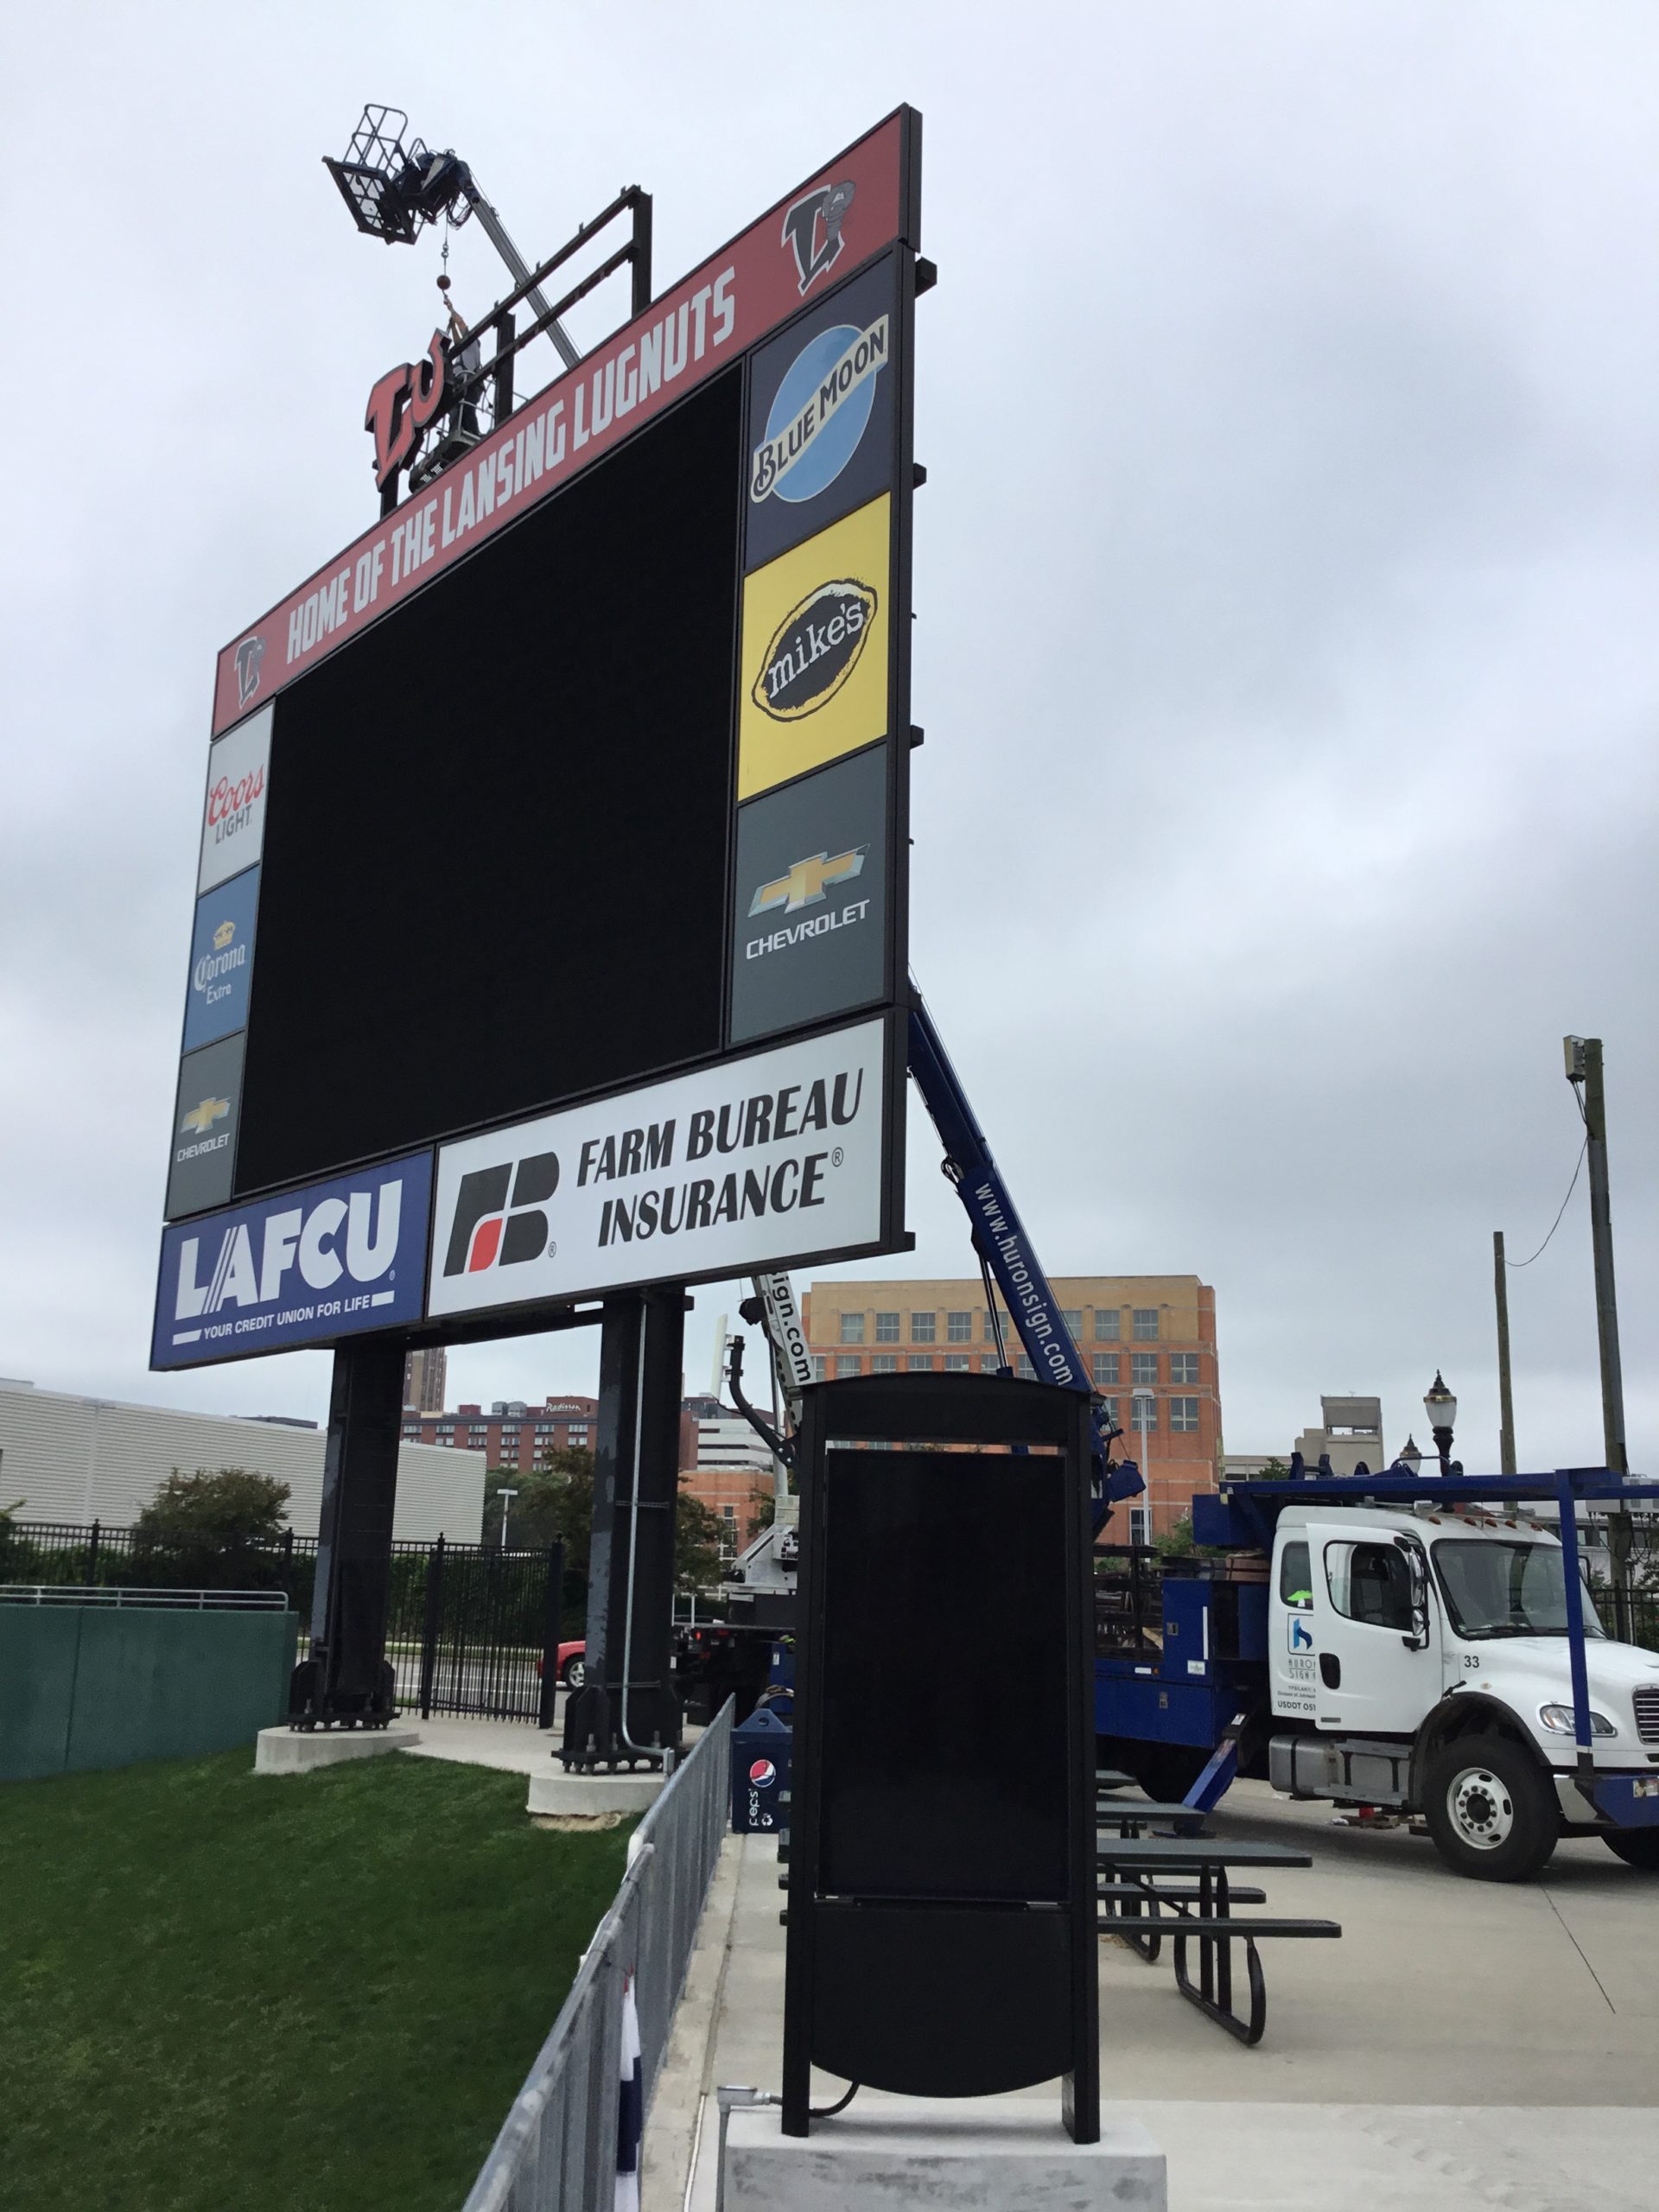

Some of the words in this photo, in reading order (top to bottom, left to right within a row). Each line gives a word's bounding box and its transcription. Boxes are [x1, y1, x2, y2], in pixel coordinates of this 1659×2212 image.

[820, 324, 885, 422] MOON
[287, 567, 351, 664] HOME
[353, 540, 385, 613] OF
[391, 499, 437, 587] THE
[442, 399, 566, 549] LANSING
[574, 266, 735, 452] LUGNUTS
[768, 601, 864, 698] mike's
[208, 764, 264, 826] Coors
[215, 804, 253, 844] LIGHT
[746, 899, 870, 960] CHEVROLET
[194, 944, 245, 993] Corona
[207, 984, 232, 1004] Extra
[177, 1133, 231, 1162] CHEVROLET
[577, 1119, 676, 1187] FARM
[686, 1067, 863, 1162] BUREAU
[175, 1179, 403, 1321] LAFCU
[975, 1182, 1074, 1386] www.huronsign.com
[204, 1322, 232, 1340] YOUR
[235, 1314, 274, 1333] CREDIT
[276, 1306, 314, 1326] UNION
[316, 1301, 341, 1318] FOR
[344, 1294, 370, 1313] LIFE
[772, 1271, 812, 1382] ign.com
[546, 1402, 581, 1412] Radisson
[1464, 1655, 1479, 1668] 33
[1277, 1700, 1300, 1710] USDOT
